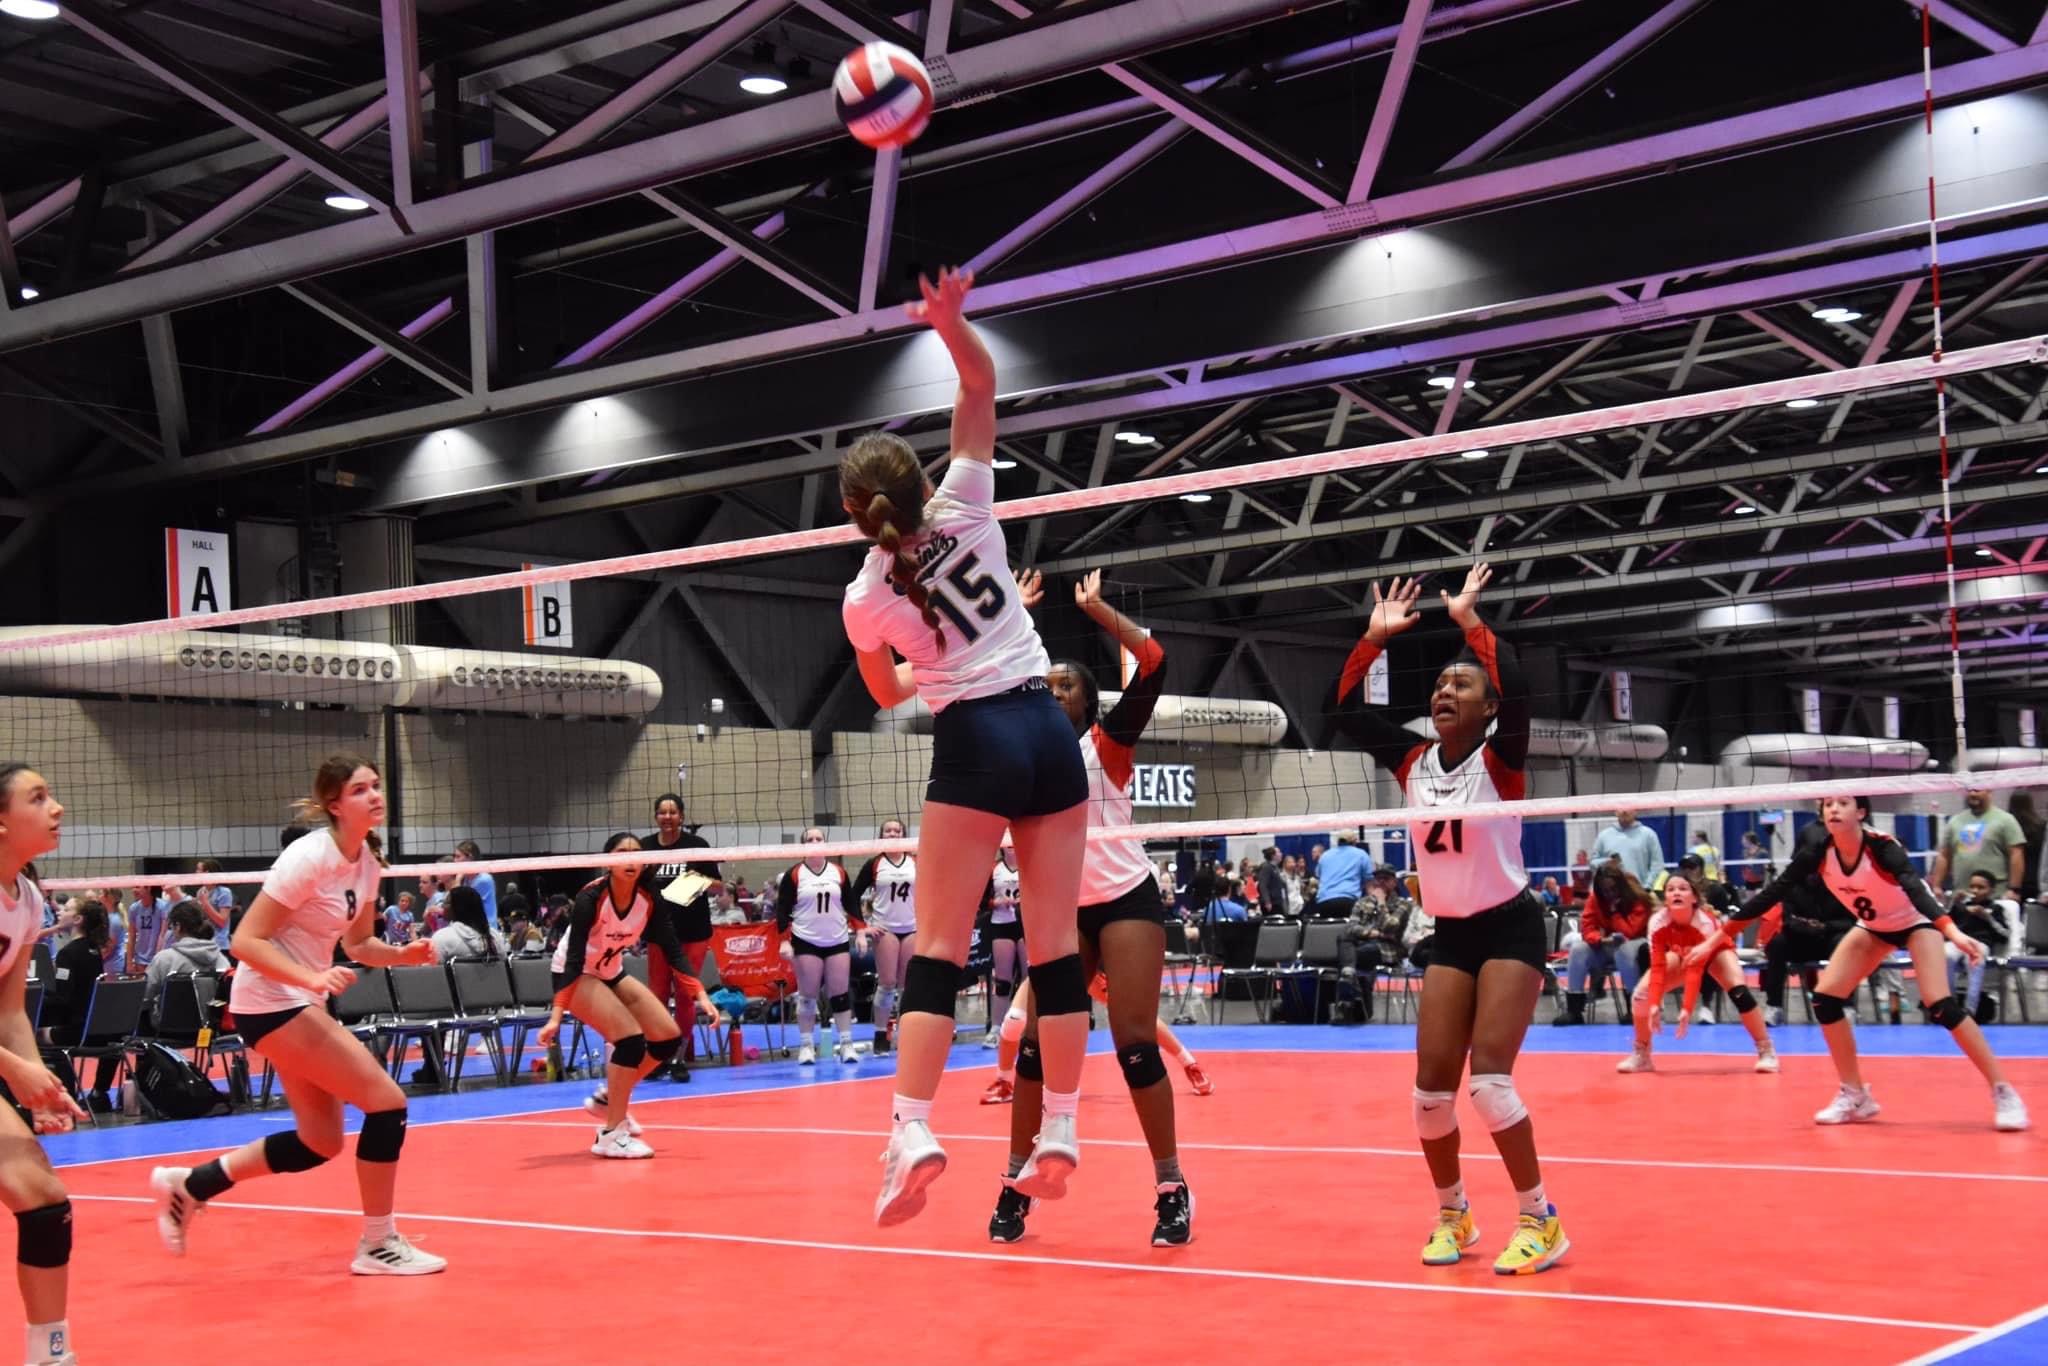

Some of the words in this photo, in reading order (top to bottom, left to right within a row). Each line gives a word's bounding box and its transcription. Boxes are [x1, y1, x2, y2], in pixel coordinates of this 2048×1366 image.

[192, 540, 214, 551] HALL
[192, 566, 219, 612] A
[927, 552, 1006, 646] 15
[543, 596, 562, 637] B
[1423, 806, 1462, 854] 21
[344, 889, 357, 920] 8
[816, 892, 831, 914] 11
[890, 882, 911, 902] 14
[1853, 896, 1876, 921] 8
[140, 916, 153, 930] 12
